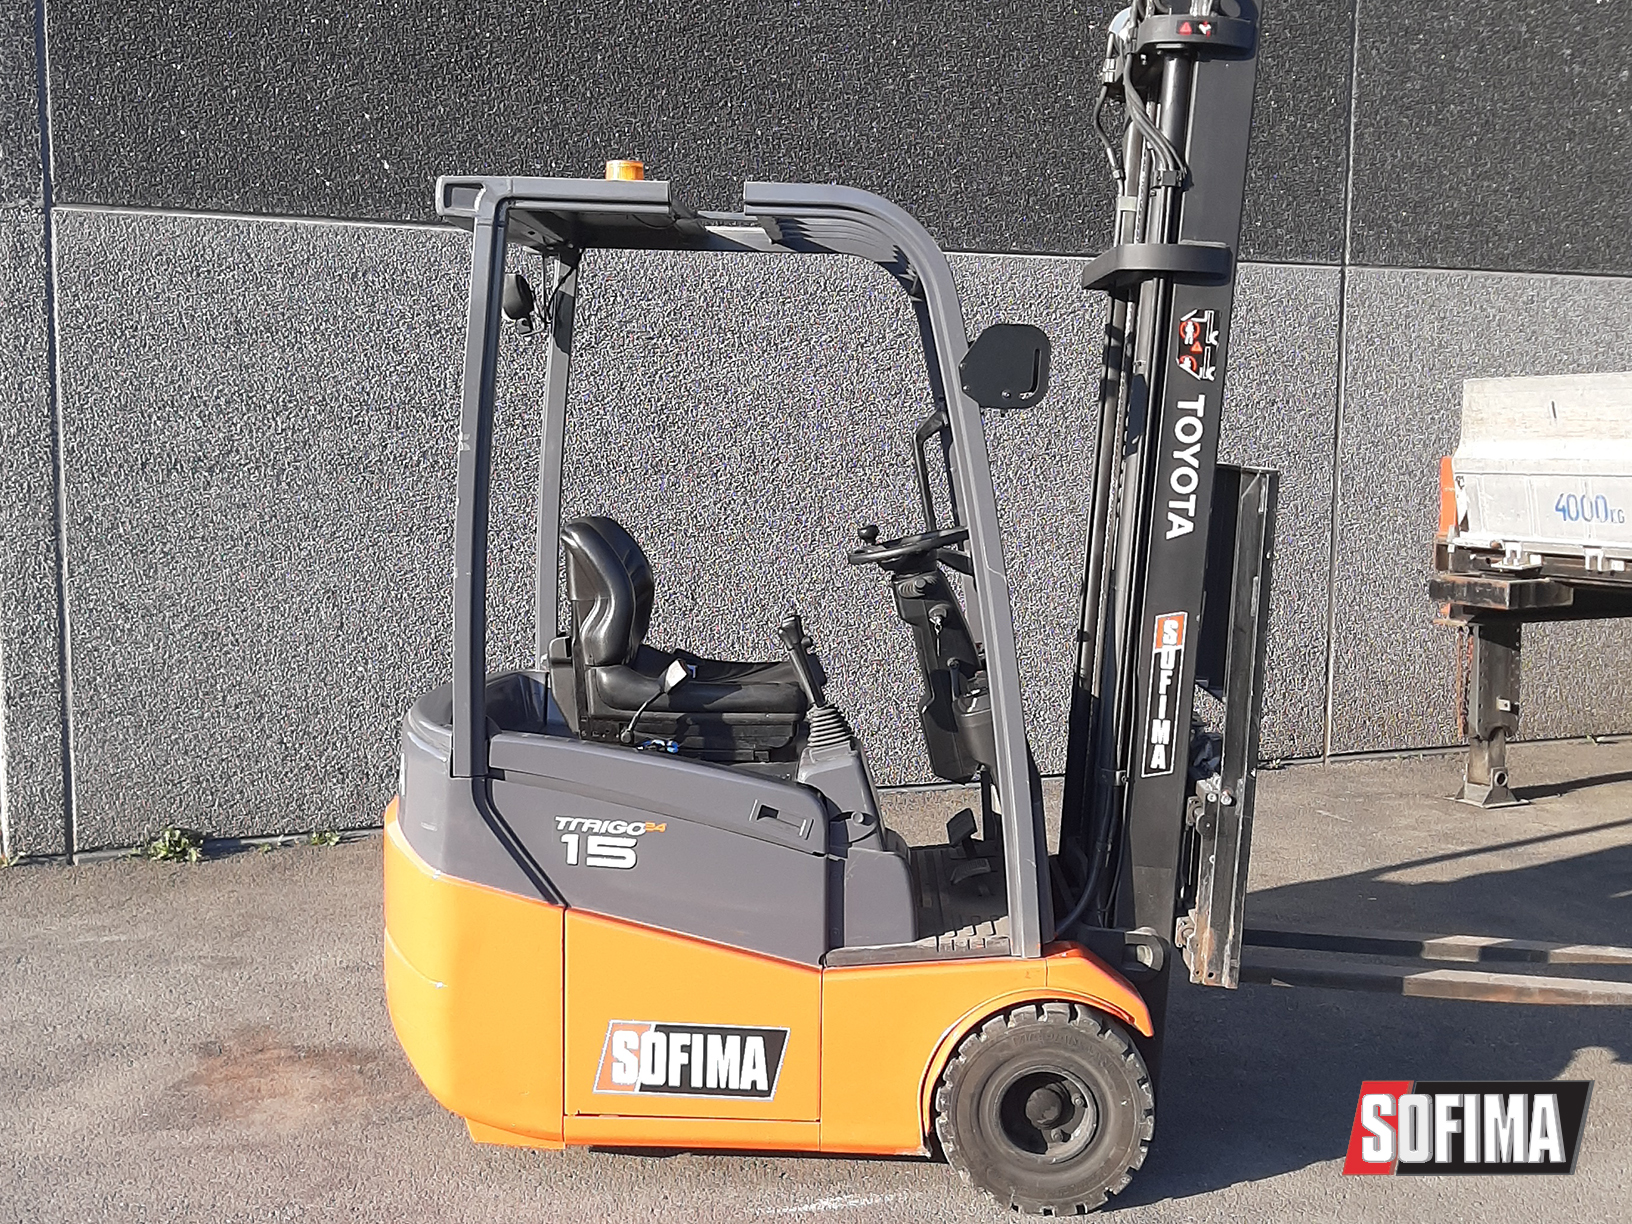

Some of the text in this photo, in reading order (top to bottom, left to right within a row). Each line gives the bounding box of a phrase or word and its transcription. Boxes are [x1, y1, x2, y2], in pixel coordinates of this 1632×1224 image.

[1165, 394, 1205, 540] TOYOTA
[1150, 619, 1179, 770] SOFIMA
[560, 833, 638, 870] 15
[611, 1030, 769, 1091] SOFIMA
